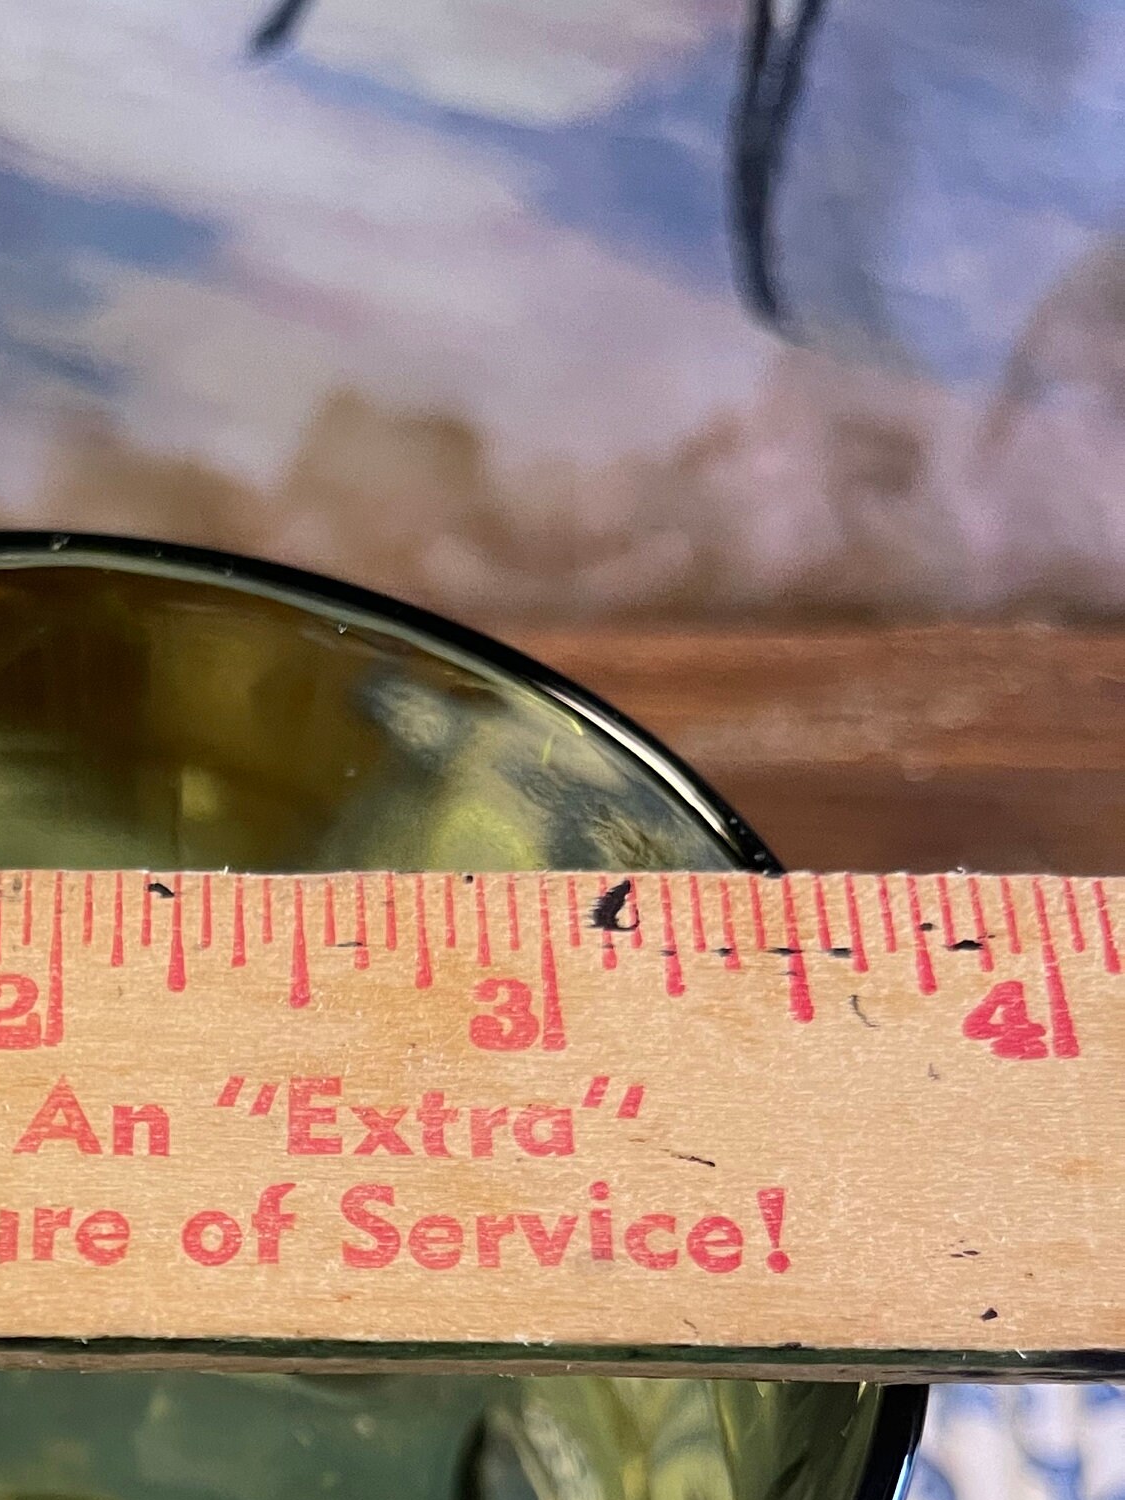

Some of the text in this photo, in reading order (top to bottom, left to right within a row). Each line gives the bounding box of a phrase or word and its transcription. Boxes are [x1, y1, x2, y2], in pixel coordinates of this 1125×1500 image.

[469, 978, 538, 1052] 3
[963, 980, 1049, 1060] 4
[13, 1075, 171, 1158] An
[215, 1075, 646, 1159] "Extra"
[181, 1181, 297, 1264] of
[341, 1180, 793, 1275] Service!
